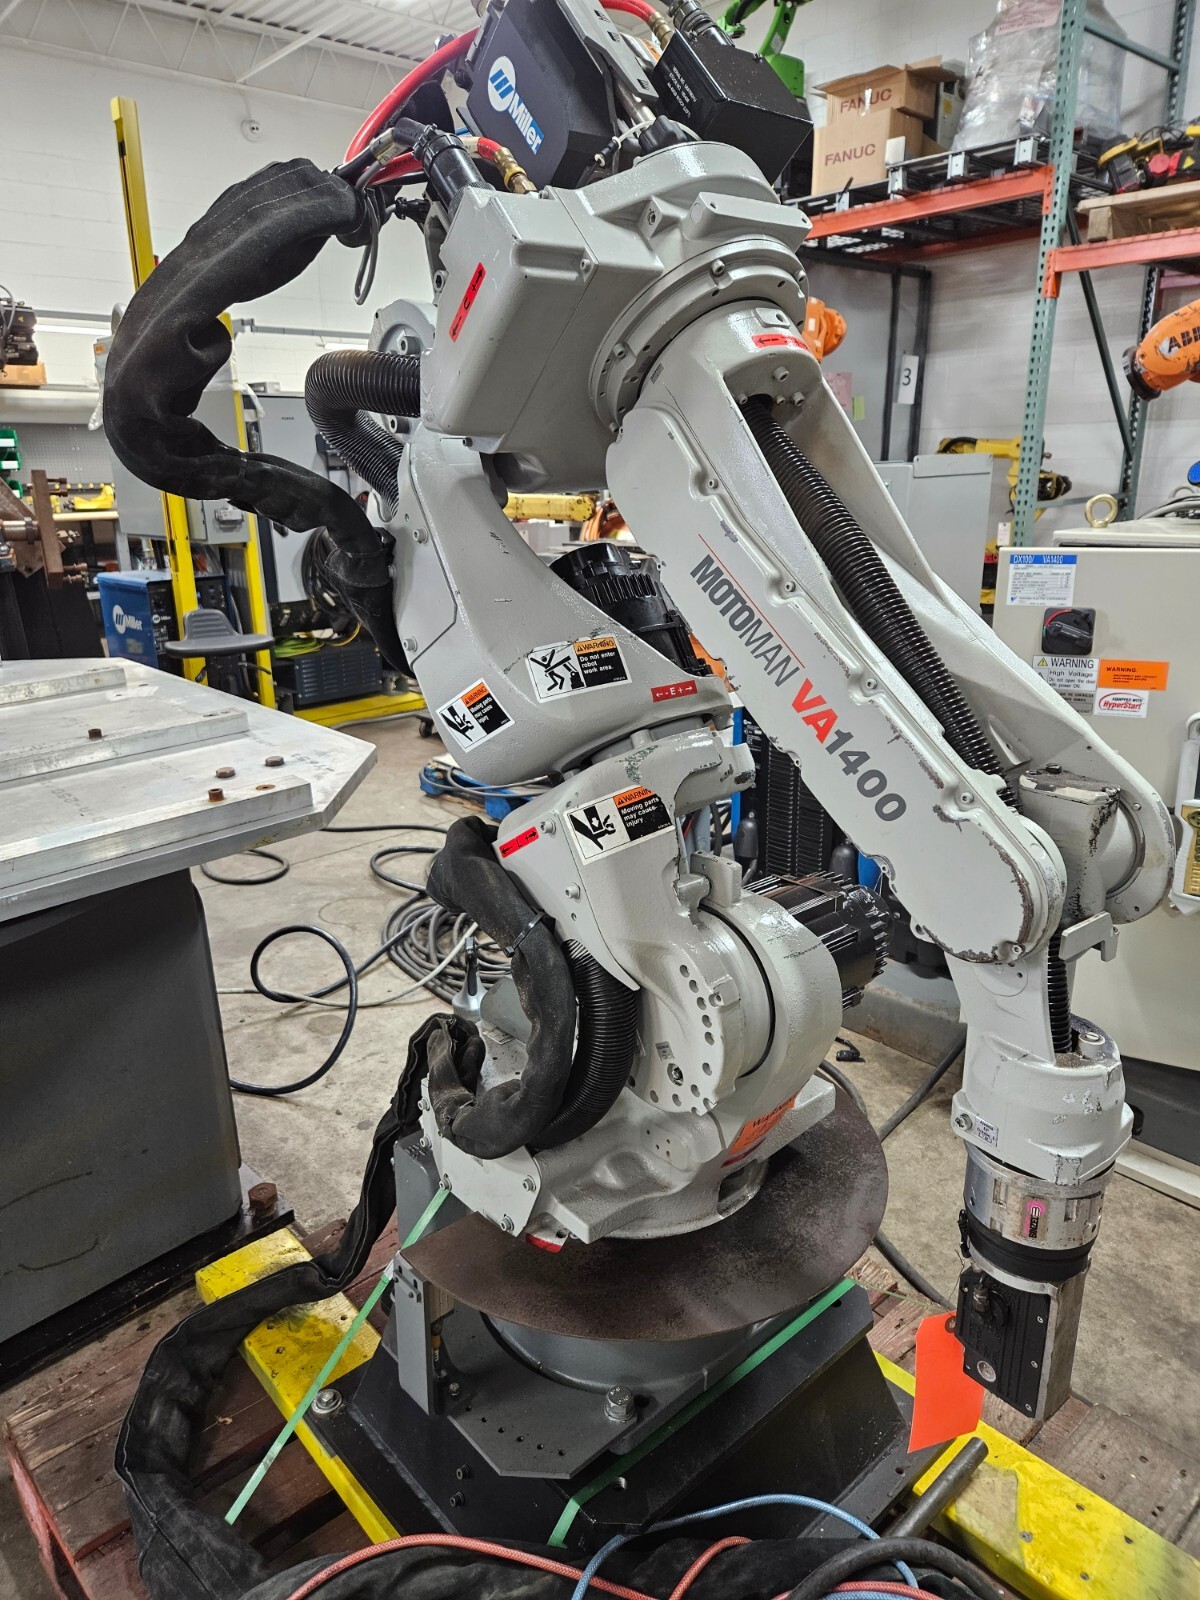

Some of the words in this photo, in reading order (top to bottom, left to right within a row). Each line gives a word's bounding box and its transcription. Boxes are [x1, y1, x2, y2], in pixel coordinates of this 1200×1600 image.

[840, 88, 892, 113] FANUC
[508, 92, 543, 155] Miller
[825, 143, 876, 166] FANUC
[902, 367, 912, 387] 3
[124, 614, 142, 631] Miller
[690, 554, 800, 687] MOTOMAN
[583, 640, 615, 650] WARNING
[1051, 658, 1094, 669] WARNING
[470, 702, 484, 713] Moving
[482, 697, 493, 706] parts
[1103, 700, 1143, 710] HyperStart
[791, 677, 907, 822] VA1400
[623, 788, 652, 803] WARNIN
[621, 803, 643, 815] Moving
[644, 797, 660, 807] parts
[623, 812, 637, 821] may
[638, 805, 656, 815] cause
[626, 817, 643, 827] injury
[1029, 1214, 1039, 1238] BINZEL
